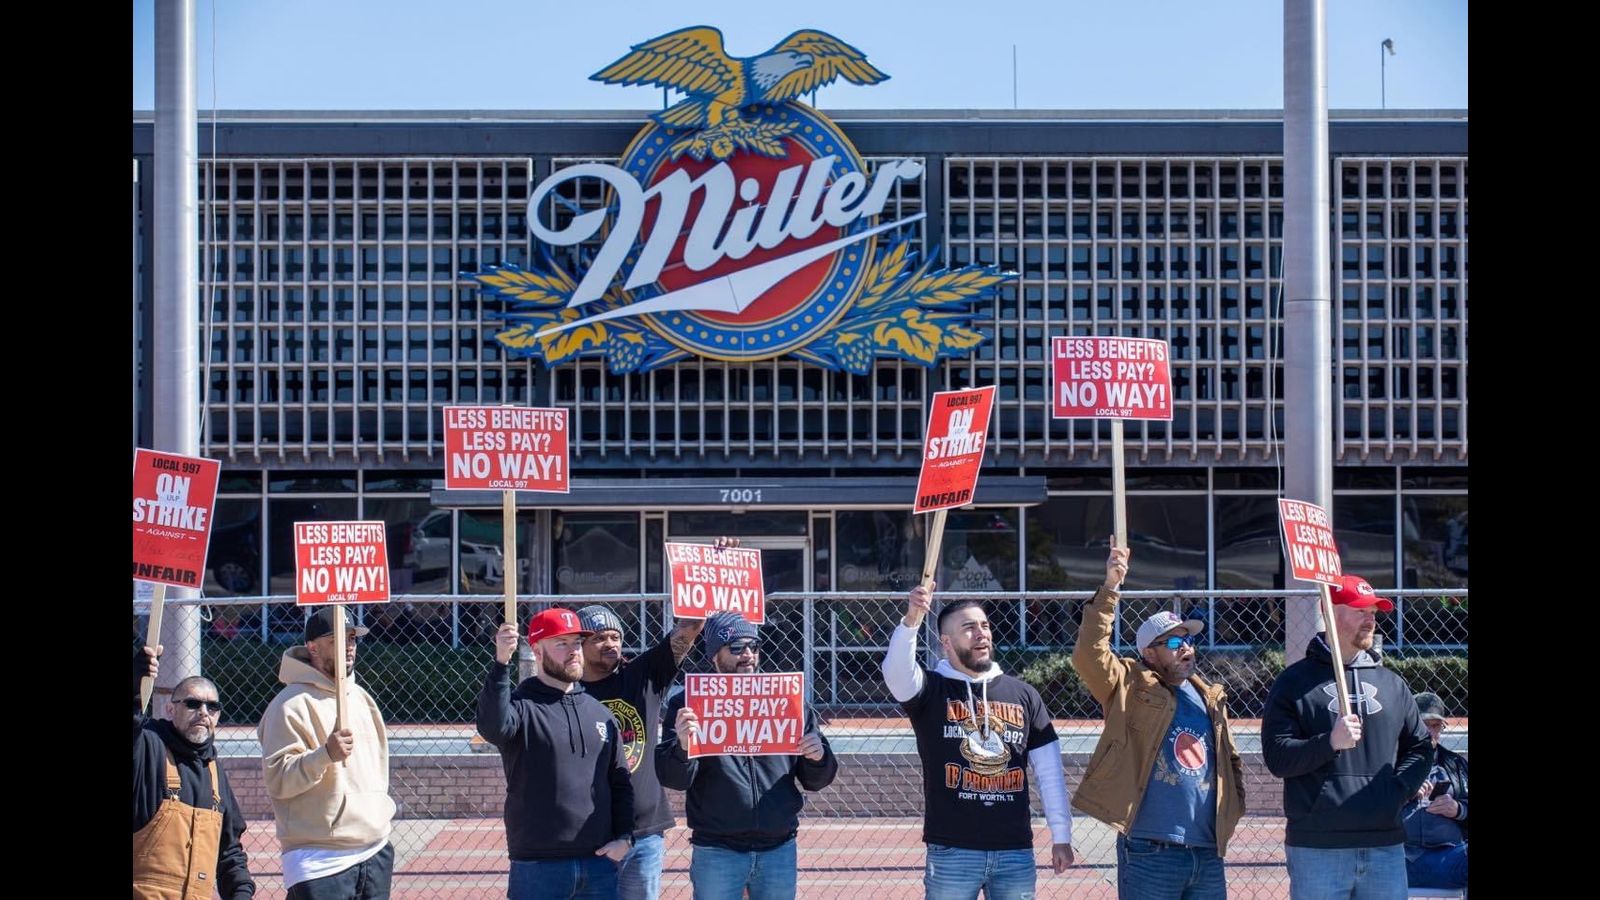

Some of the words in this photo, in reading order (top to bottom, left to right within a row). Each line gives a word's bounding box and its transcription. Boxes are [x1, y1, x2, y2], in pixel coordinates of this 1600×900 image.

[527, 155, 925, 308] Miller
[1057, 340, 1094, 358] LESS
[1099, 340, 1165, 361] BENEFITS
[1071, 361, 1112, 380] LESS
[1117, 362, 1155, 381] PAY?
[947, 396, 969, 407] LOCAL
[1060, 381, 1098, 408] NO
[1105, 382, 1165, 409] WAY!
[449, 410, 487, 429] LESS
[492, 410, 564, 431] BENEFITS
[948, 408, 975, 433] ON
[463, 431, 506, 451] LESS
[511, 432, 551, 452] PAY?
[928, 431, 984, 460] STRIKE
[152, 458, 180, 472] LOCAL
[181, 463, 201, 474] 997
[453, 453, 491, 479] NO
[498, 453, 562, 481] WAY!
[156, 473, 191, 504] ON
[489, 480, 513, 488] LOCAL
[720, 489, 762, 503] 7001
[920, 489, 971, 508] UNFAIR
[133, 498, 207, 532] STRIKE
[1282, 502, 1306, 522] LESS
[146, 528, 187, 540] AGAINST
[299, 525, 328, 544] LESS
[331, 525, 383, 543] BENEFITS
[1294, 524, 1318, 545] LESS
[311, 546, 341, 565] LESS
[345, 546, 376, 565] PAY?
[670, 545, 701, 562] LESS
[703, 548, 758, 569] BENEFITS
[1292, 543, 1316, 571] NO
[302, 567, 330, 593] NO
[335, 566, 385, 592] WAY!
[684, 565, 717, 583] LESS
[720, 568, 750, 587] PAY?
[347, 593, 359, 601] 997
[677, 583, 707, 609] NO
[711, 586, 759, 614] WAY!
[561, 612, 574, 628] T
[690, 677, 728, 696] LESS
[732, 676, 800, 696] BENEFITS
[703, 699, 744, 718] LESS
[749, 698, 788, 718] PAY?
[608, 702, 635, 718] STRIKE
[632, 716, 644, 745] HARD
[692, 720, 727, 746] NO
[736, 718, 798, 744] WAY!
[943, 725, 968, 738] LOCAL
[748, 745, 761, 753] 997
[958, 792, 977, 801] FORT
